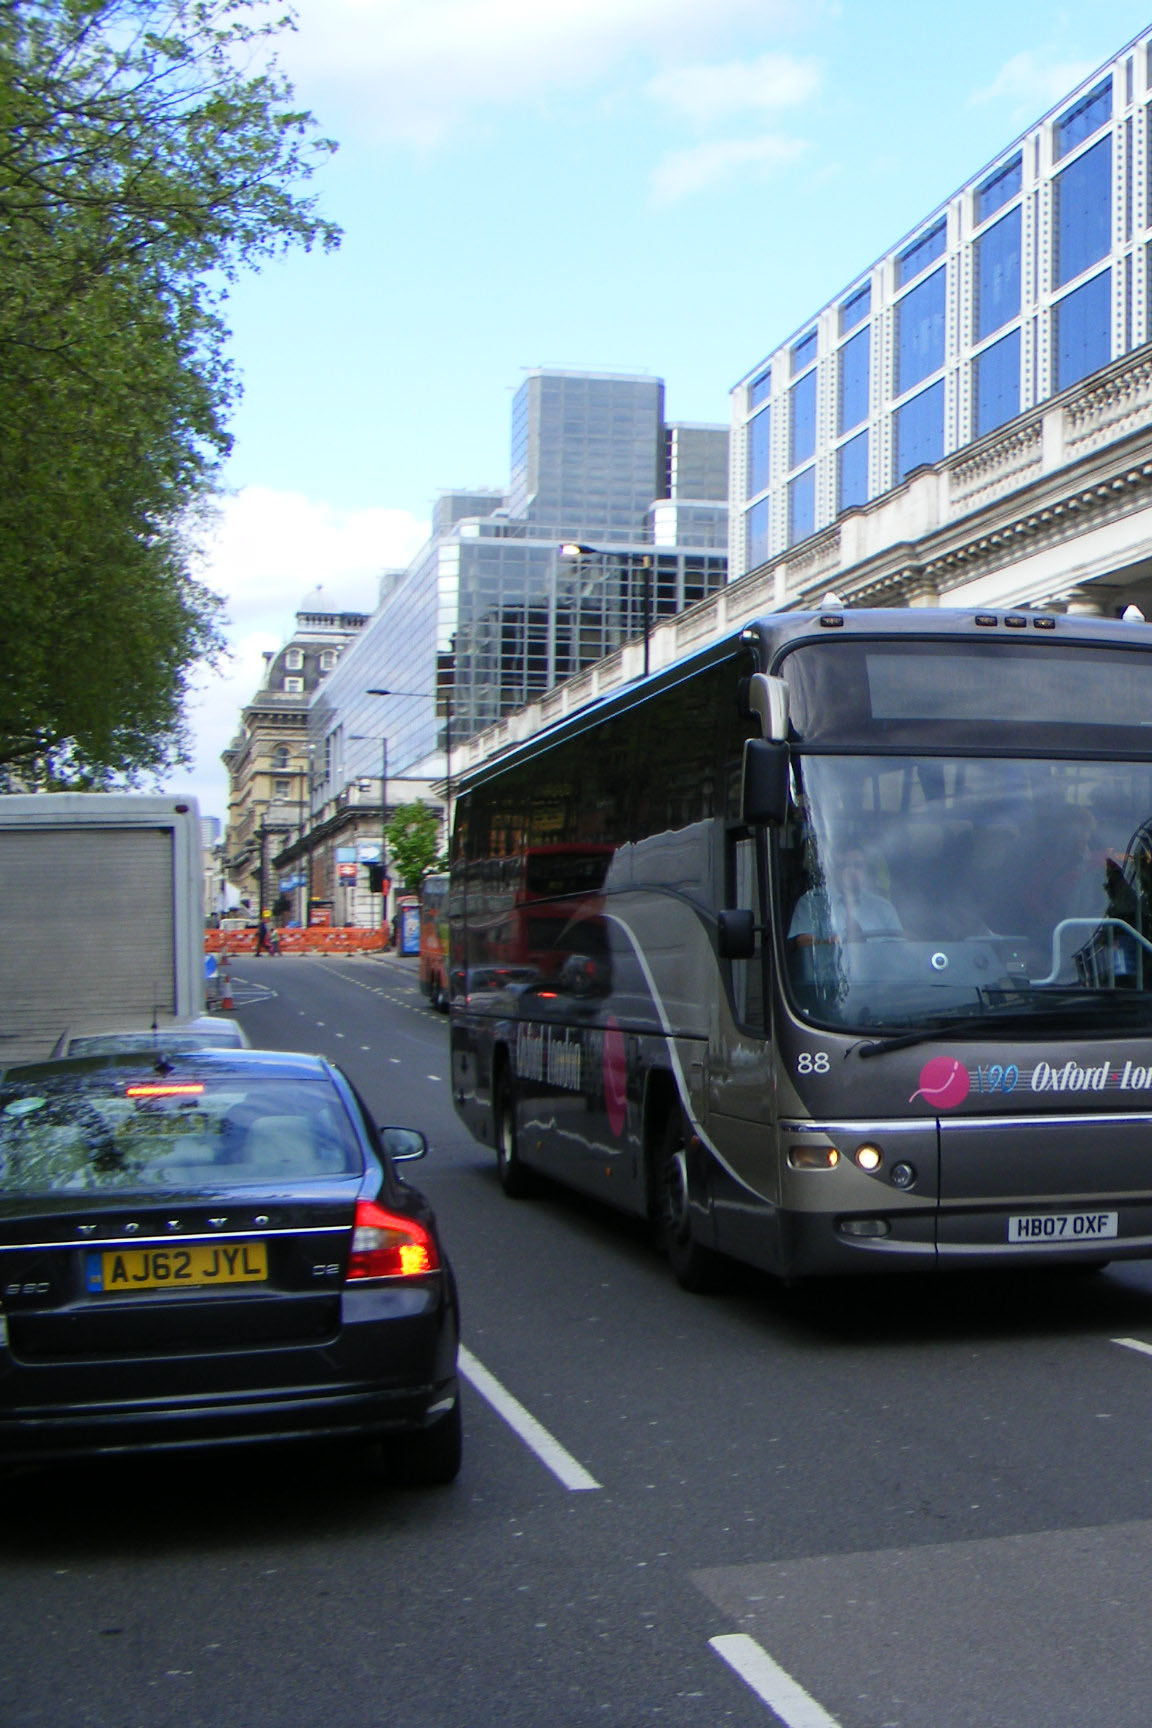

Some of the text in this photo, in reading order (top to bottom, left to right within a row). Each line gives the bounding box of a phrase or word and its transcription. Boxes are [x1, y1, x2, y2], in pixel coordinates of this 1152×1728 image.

[798, 1052, 830, 1074] 88
[1031, 1061, 1111, 1092] Oxford
[77, 1215, 269, 1235] VOLVO
[1018, 1215, 1109, 1237] HB07 OXF
[111, 1248, 261, 1283] AJ62 JYL
